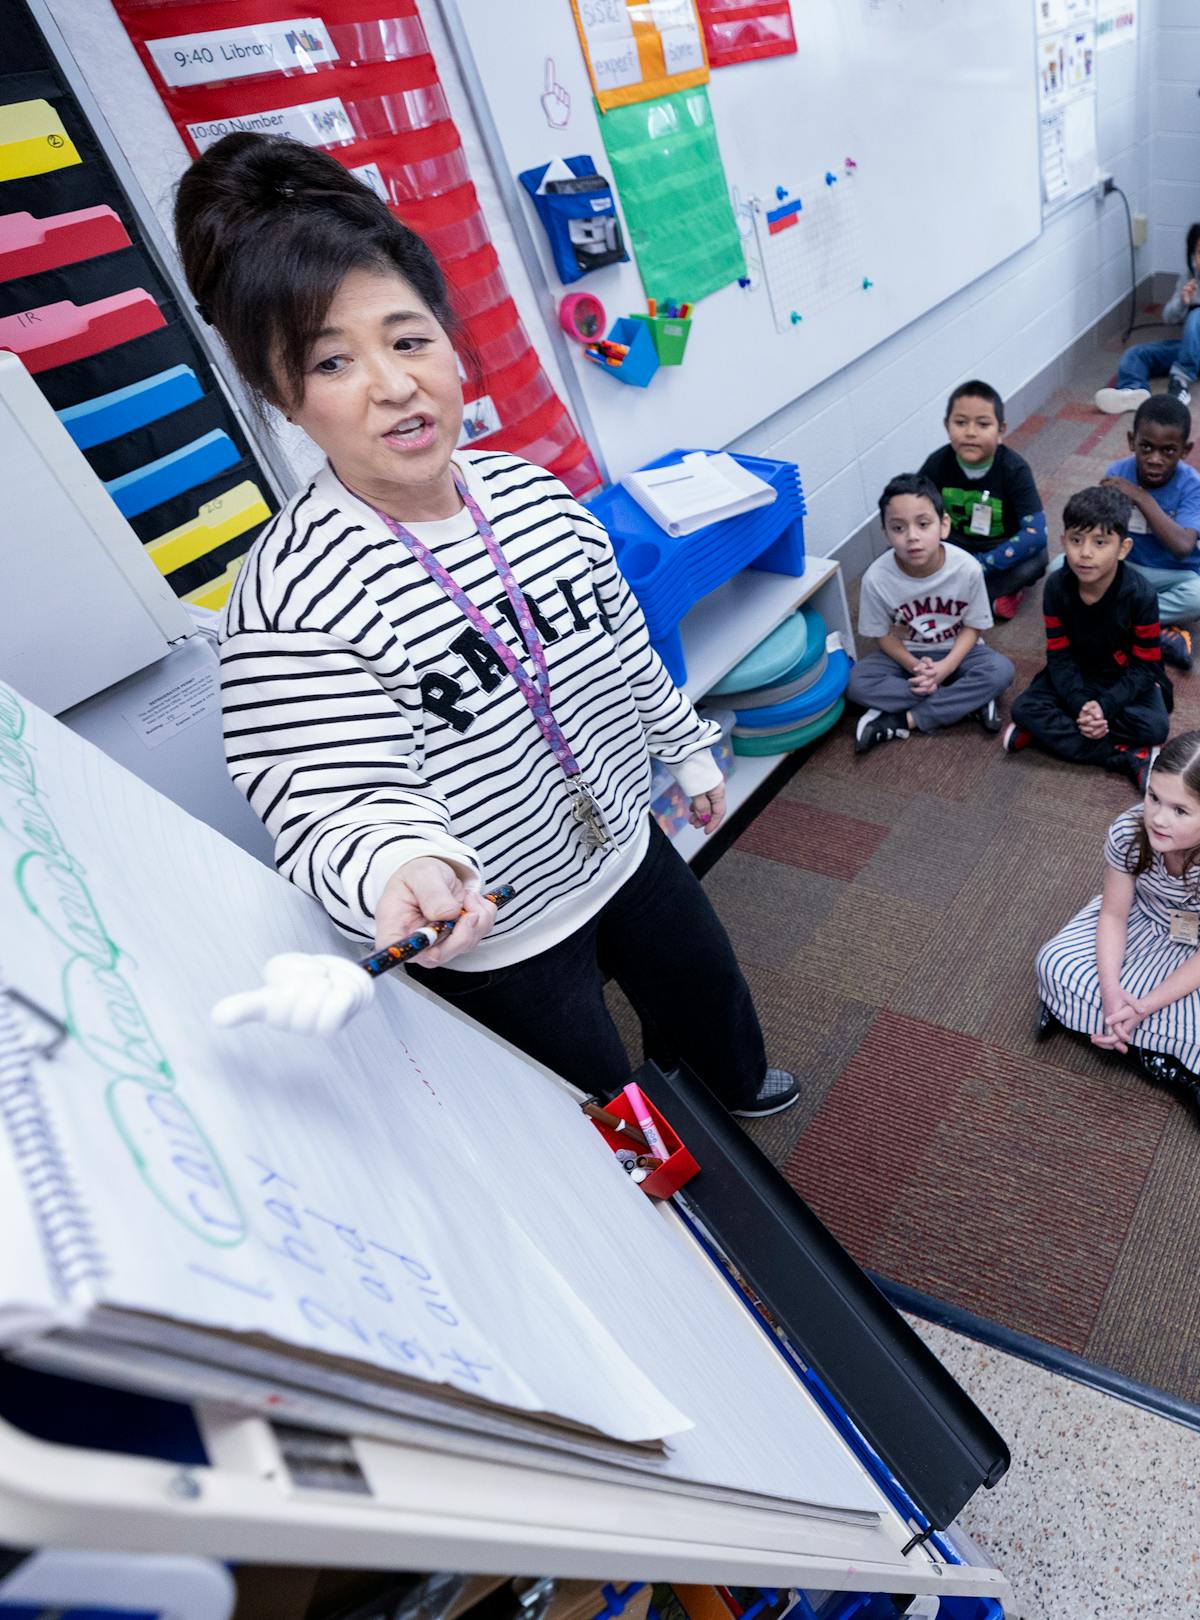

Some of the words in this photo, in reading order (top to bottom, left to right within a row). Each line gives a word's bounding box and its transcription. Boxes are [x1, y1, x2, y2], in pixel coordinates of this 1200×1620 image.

[174, 47, 213, 67] 9:40
[220, 40, 274, 61] Library
[191, 122, 228, 139] 10:00
[230, 113, 285, 132] Number
[895, 596, 968, 623] OMMY
[145, 1092, 248, 1232] rain
[247, 1153, 327, 1276] hay
[303, 1206, 394, 1304] aid
[367, 1238, 459, 1327] aid
